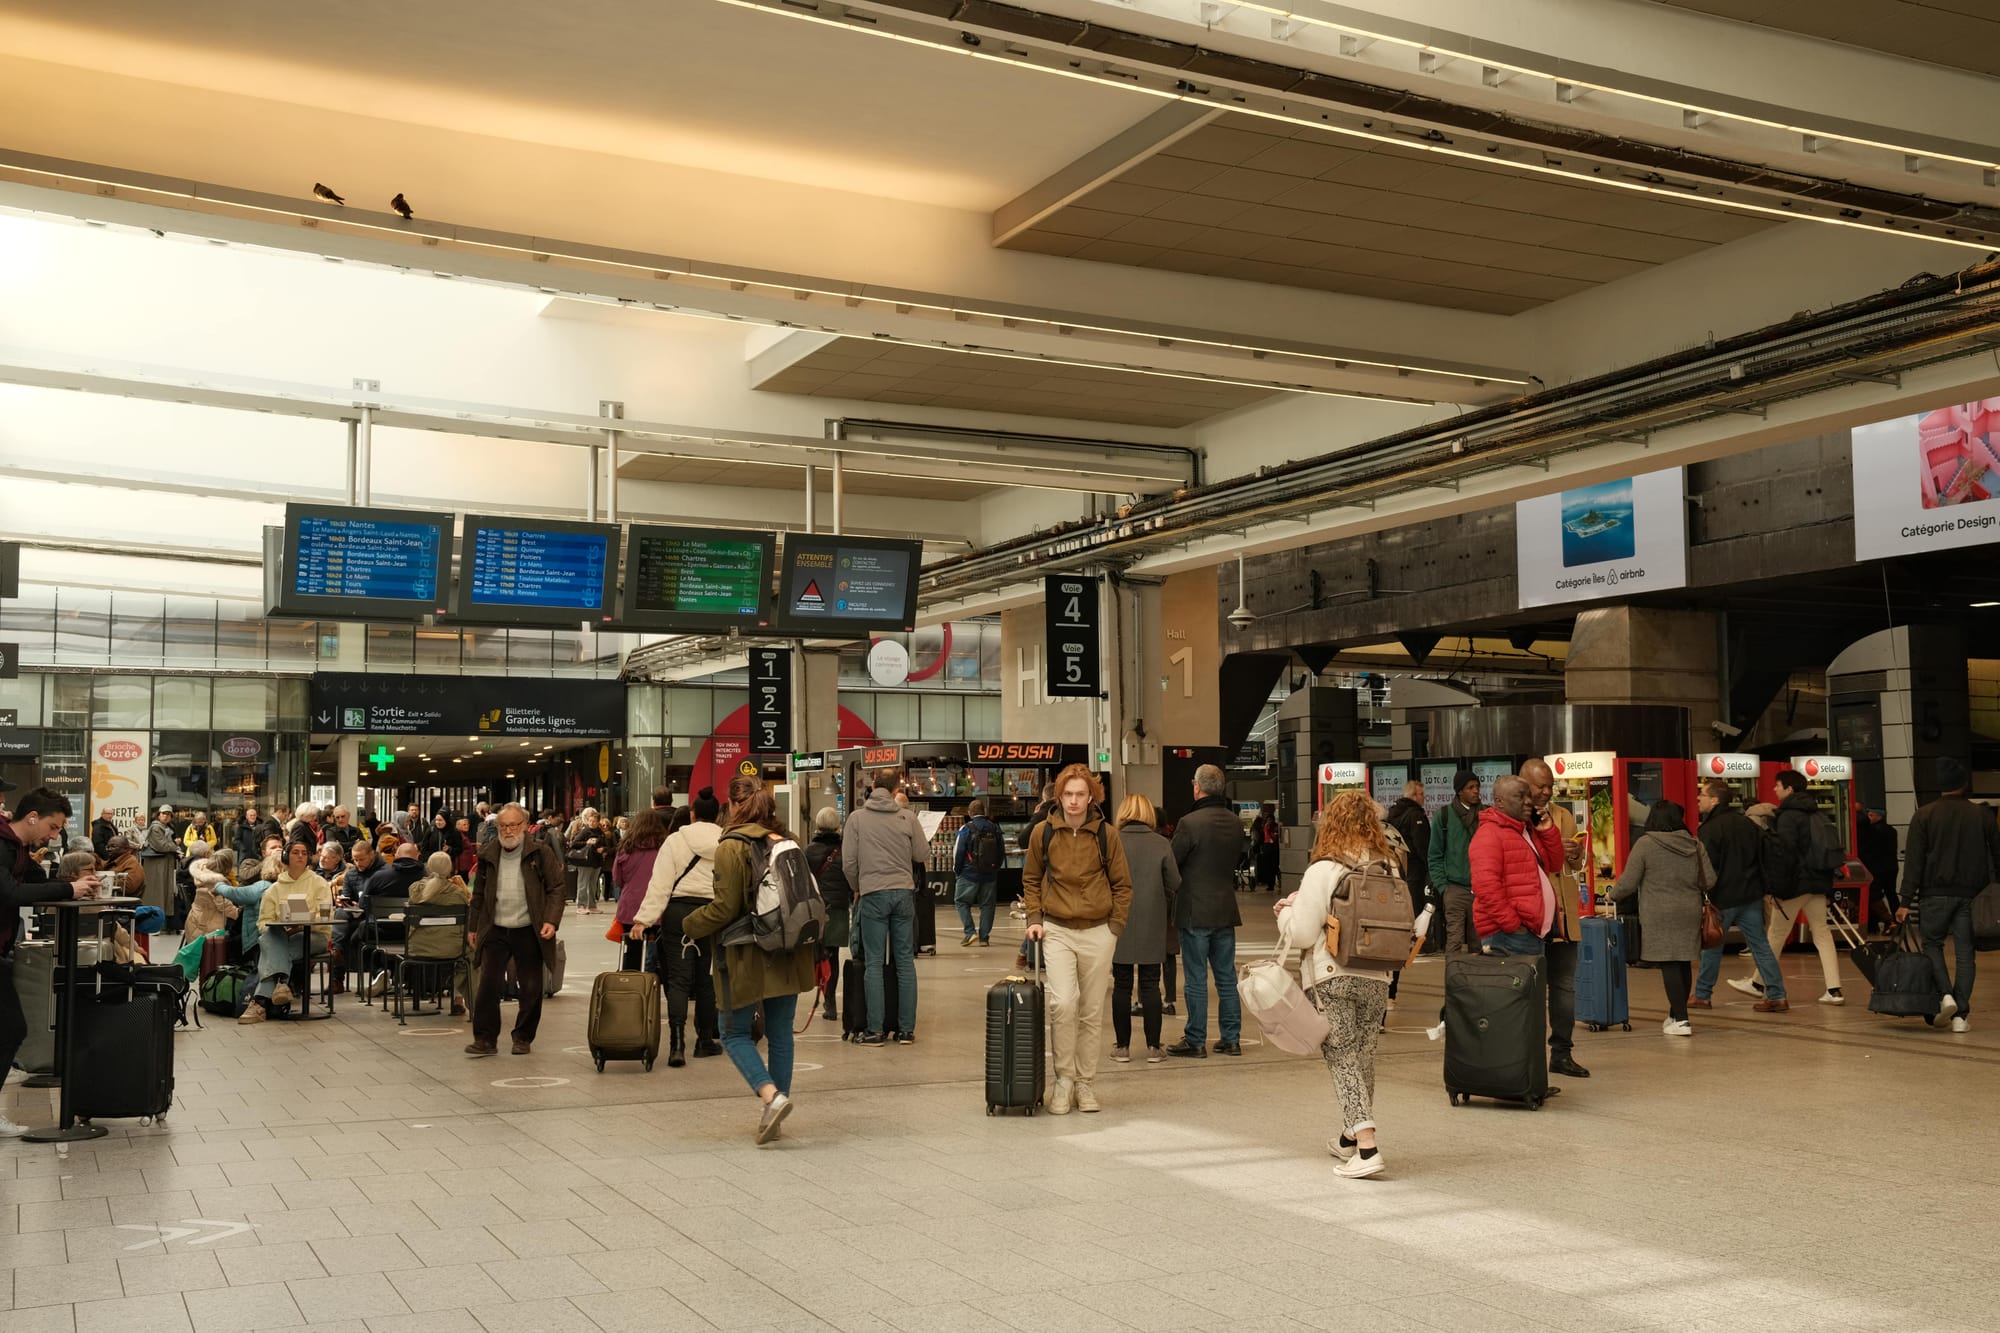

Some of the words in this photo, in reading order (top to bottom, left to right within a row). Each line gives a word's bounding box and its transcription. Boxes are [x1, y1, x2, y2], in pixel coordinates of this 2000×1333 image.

[348, 521, 376, 529] Nantes
[1901, 521, 1955, 538] Catégorie
[1957, 515, 1996, 529] Design
[348, 536, 382, 545] Bordeaux
[383, 538, 423, 547] Saint-Jean
[367, 544, 399, 552] Saint-Jean
[346, 551, 375, 559] Bordeaux
[376, 552, 408, 560] Saint-Jean
[520, 554, 542, 562] Poitiers
[796, 553, 833, 561] ATTENTIFS
[346, 558, 375, 566] Bordeaux
[375, 560, 407, 568] Saint-Jean
[796, 560, 833, 568] ENSEMBLE
[346, 565, 372, 573] Chartres
[519, 568, 545, 576] Bordeaux
[546, 569, 576, 577] Saint-Jean
[1555, 576, 1591, 589] Catégorie
[1619, 568, 1645, 580] airbnb
[517, 582, 541, 590] Chartres
[345, 588, 366, 596] Nantes
[1064, 597, 1081, 622] 4
[1167, 629, 1186, 640] Hall
[765, 661, 773, 677] 1
[1066, 657, 1082, 683] 5
[1169, 646, 1193, 697] 1
[764, 695, 775, 711] 2
[371, 706, 406, 717] Sortie
[505, 708, 541, 716] Billetterie
[505, 715, 546, 725] Grandes
[548, 715, 576, 727] lignes
[764, 729, 775, 746] 3
[103, 750, 138, 759] Dorée
[876, 748, 898, 762] SUSHI
[978, 745, 1005, 759] YO!
[1006, 745, 1055, 759] SUSHI
[1567, 760, 1593, 770] selecta
[1726, 762, 1752, 771] selecta
[1820, 764, 1845, 773] selecta
[1334, 768, 1355, 778] selecta
